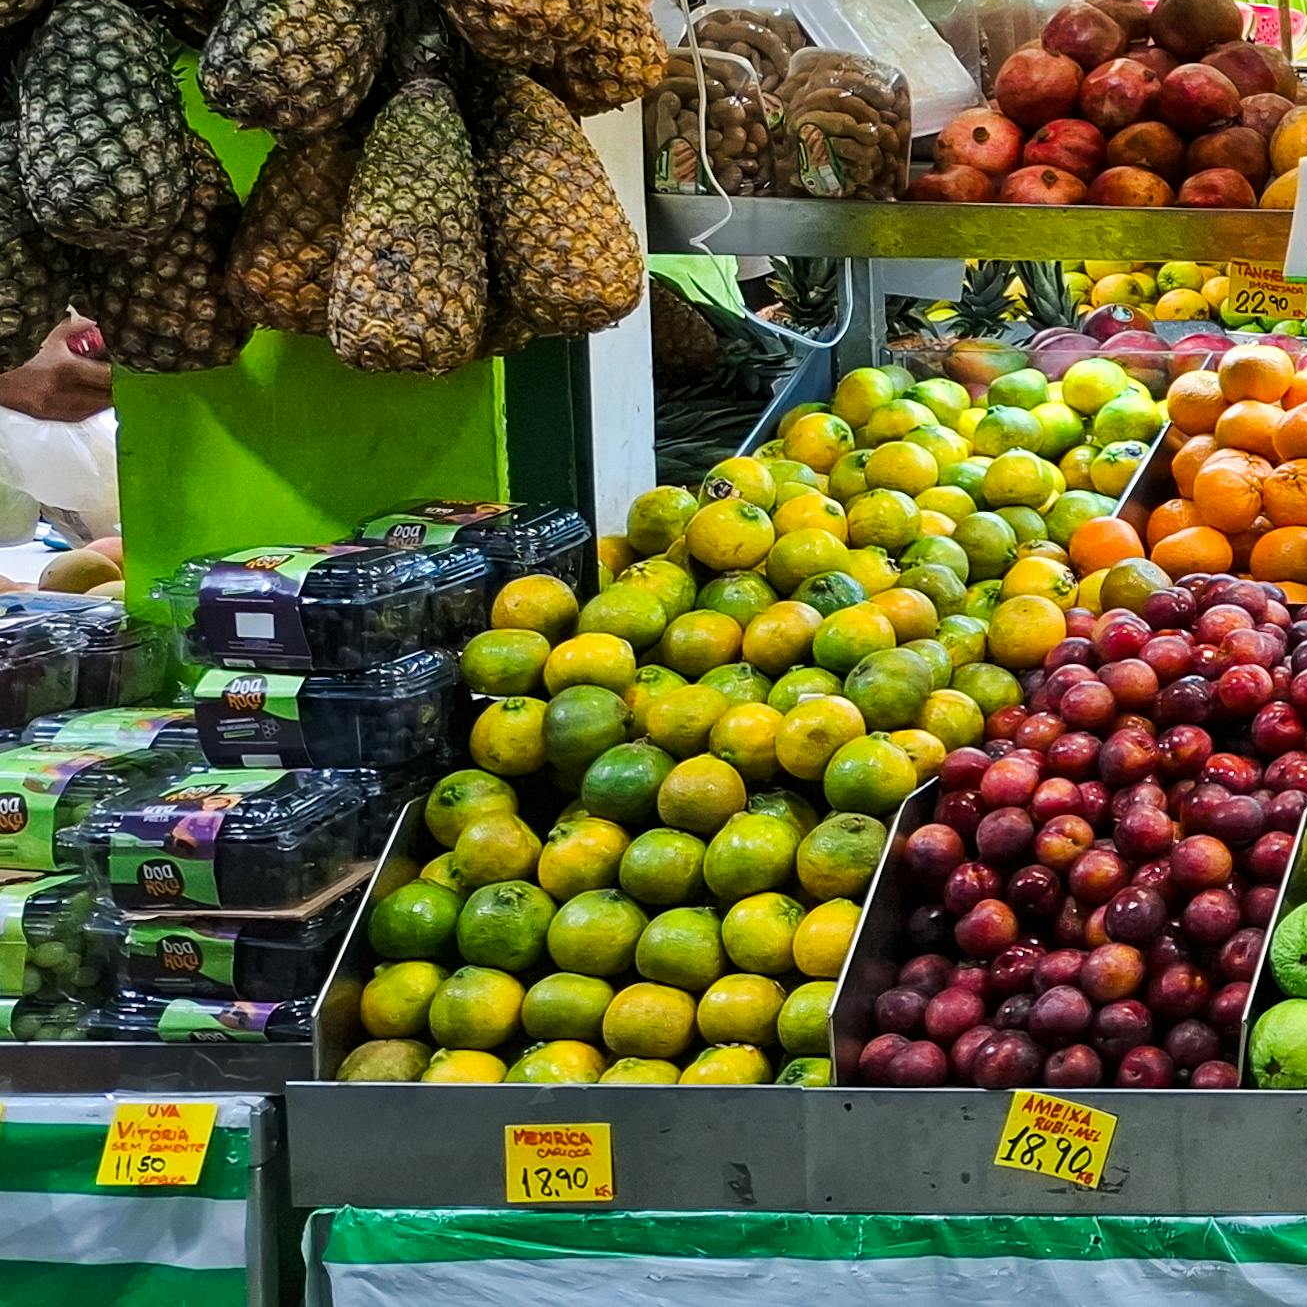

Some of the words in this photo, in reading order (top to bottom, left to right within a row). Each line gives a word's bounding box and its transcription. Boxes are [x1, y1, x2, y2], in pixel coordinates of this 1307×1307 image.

[1232, 260, 1284, 282] TANGE
[1234, 289, 1288, 316] 22,90
[147, 1104, 181, 1118] UVA
[1022, 1094, 1092, 1127] AMEIXA
[1034, 1116, 1102, 1142] RUBI-MEL
[111, 1141, 141, 1152] SEM
[537, 1148, 592, 1159] CARIOCA
[1000, 1126, 1092, 1174] 18,90
[522, 1167, 588, 1198] 18,90
[1076, 1171, 1094, 1184] KG
